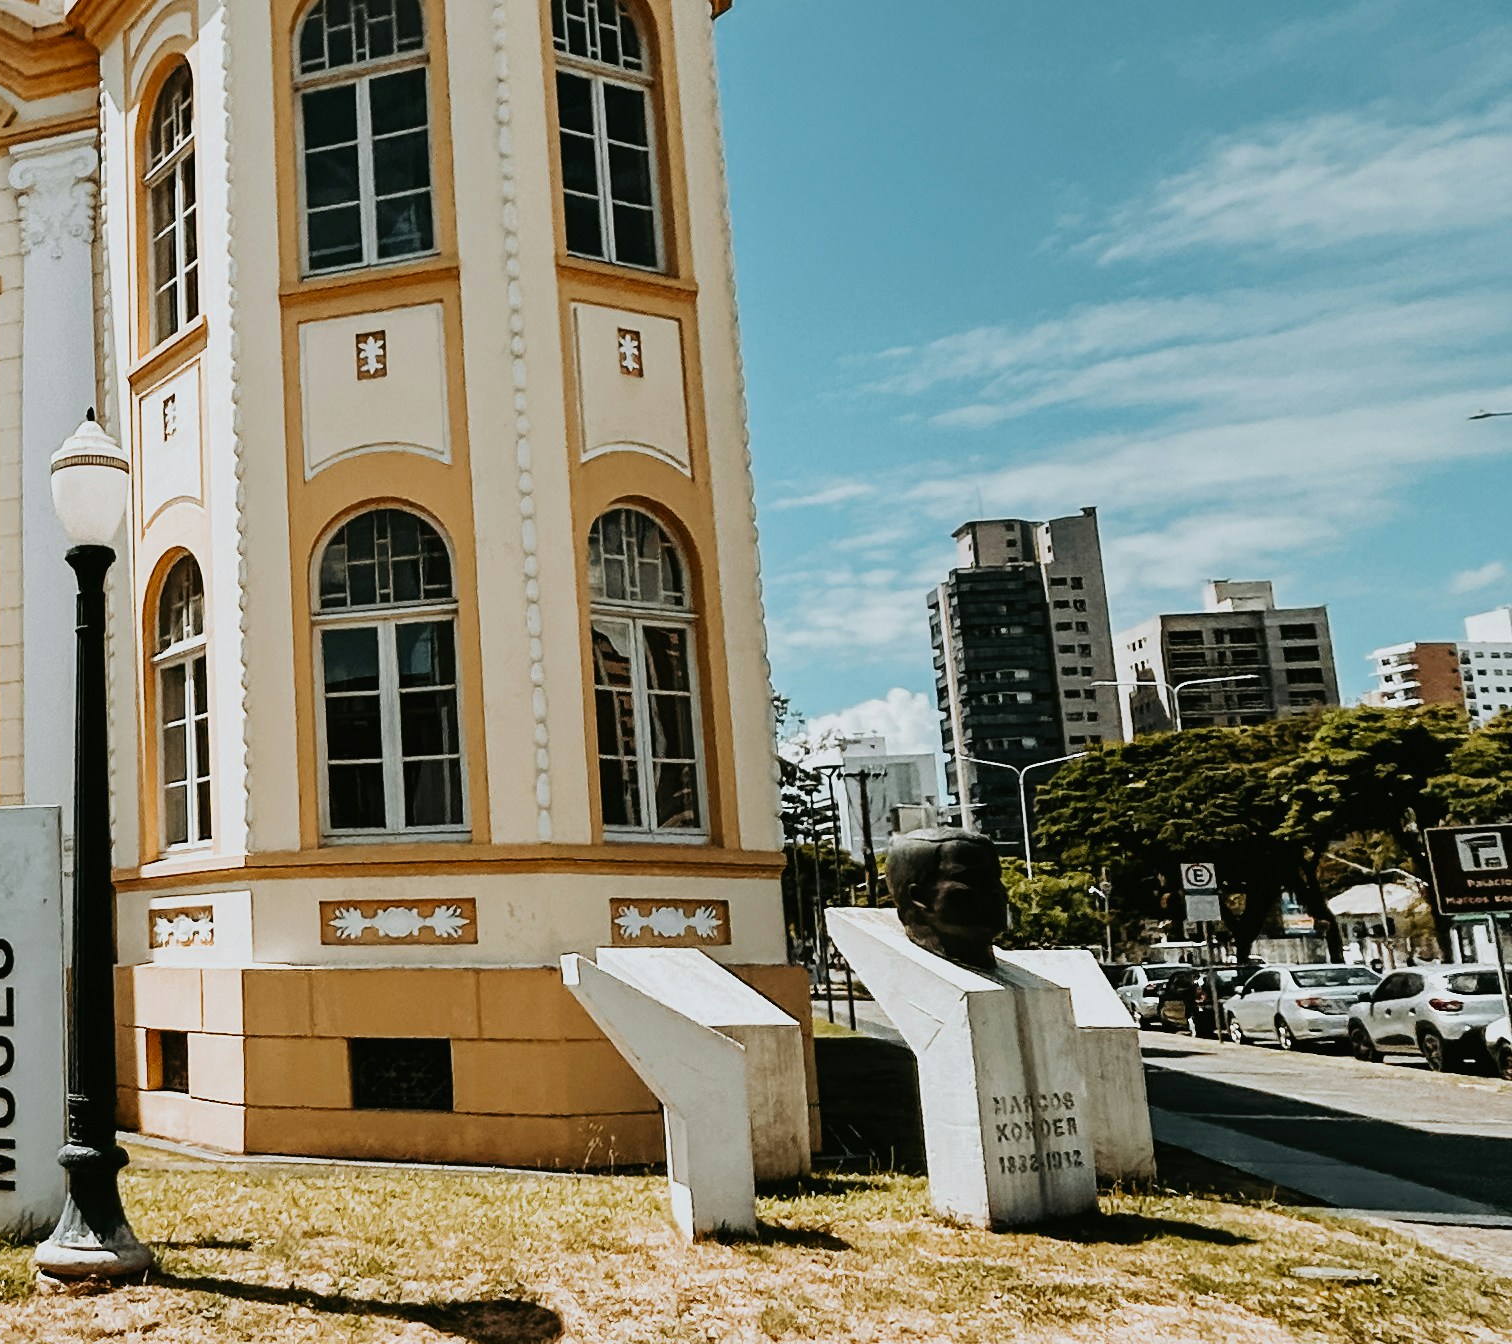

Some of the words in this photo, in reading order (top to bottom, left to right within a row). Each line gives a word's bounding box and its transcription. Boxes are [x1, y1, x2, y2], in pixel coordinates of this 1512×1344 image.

[1193, 868, 1205, 883] E
[992, 1091, 1075, 1115] MARCOS
[995, 1117, 1078, 1143] KONDER
